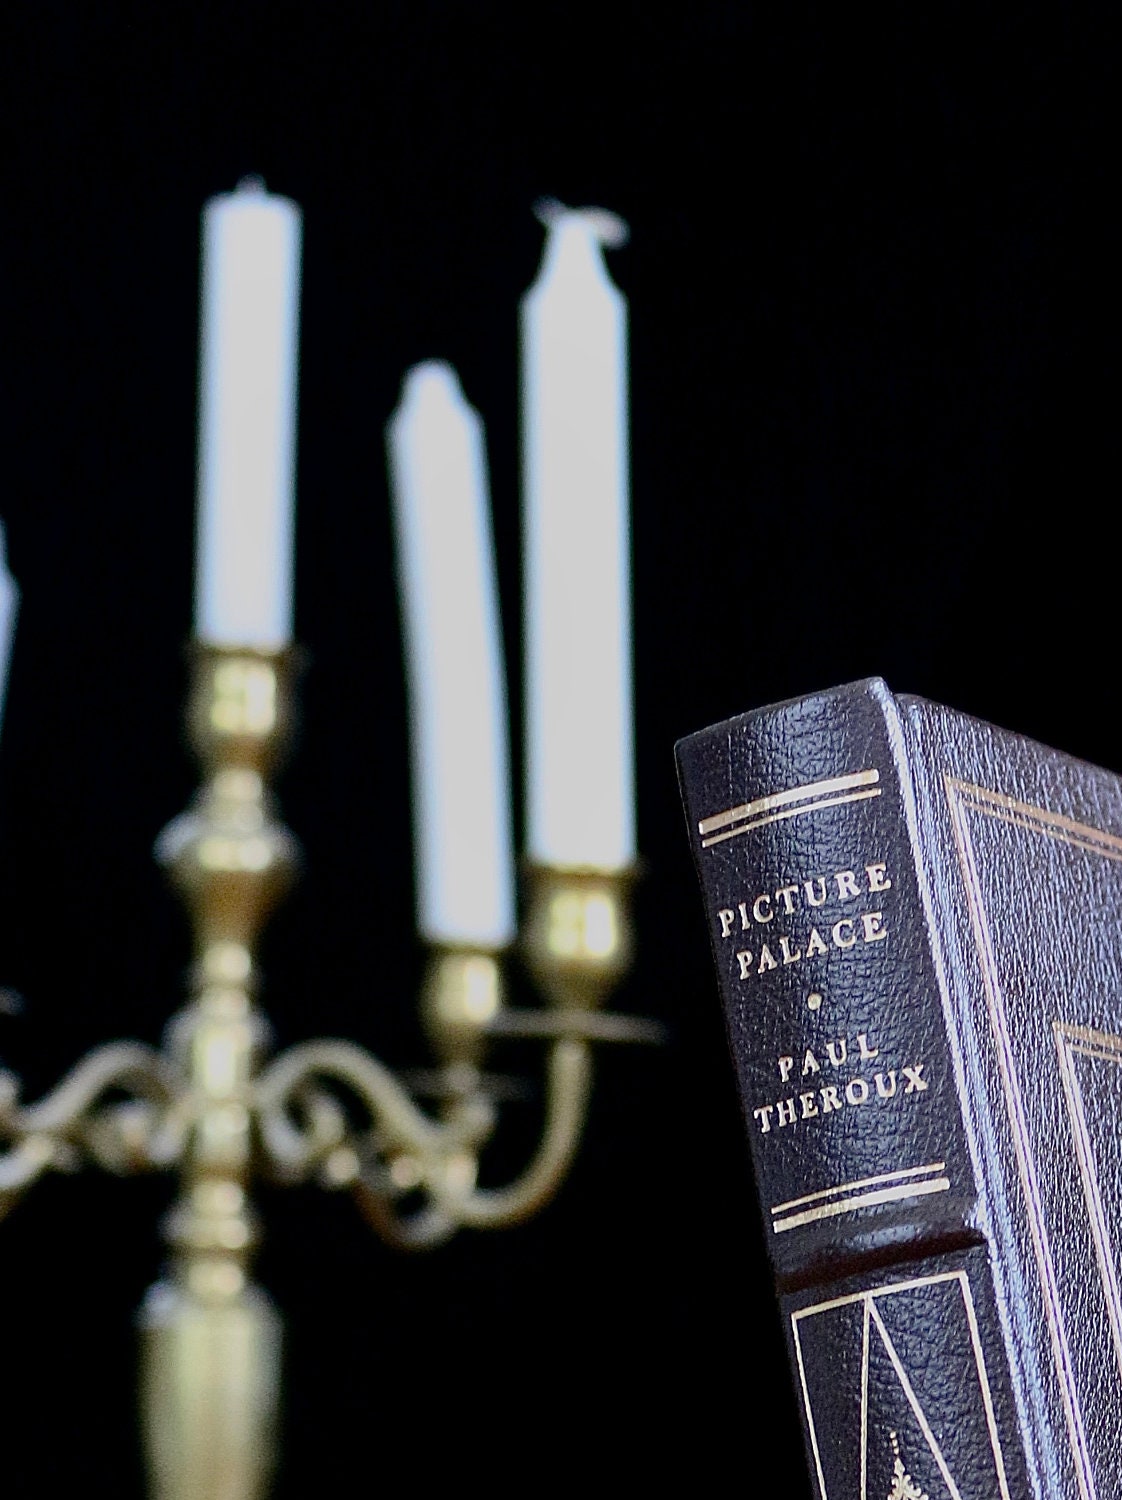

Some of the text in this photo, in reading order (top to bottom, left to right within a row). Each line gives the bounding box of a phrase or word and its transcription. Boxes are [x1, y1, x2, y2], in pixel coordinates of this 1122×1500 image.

[717, 862, 892, 938] PICTURE
[736, 912, 888, 980] PALACE
[778, 1033, 879, 1083] PAUL
[753, 1063, 929, 1133] THEROUX
